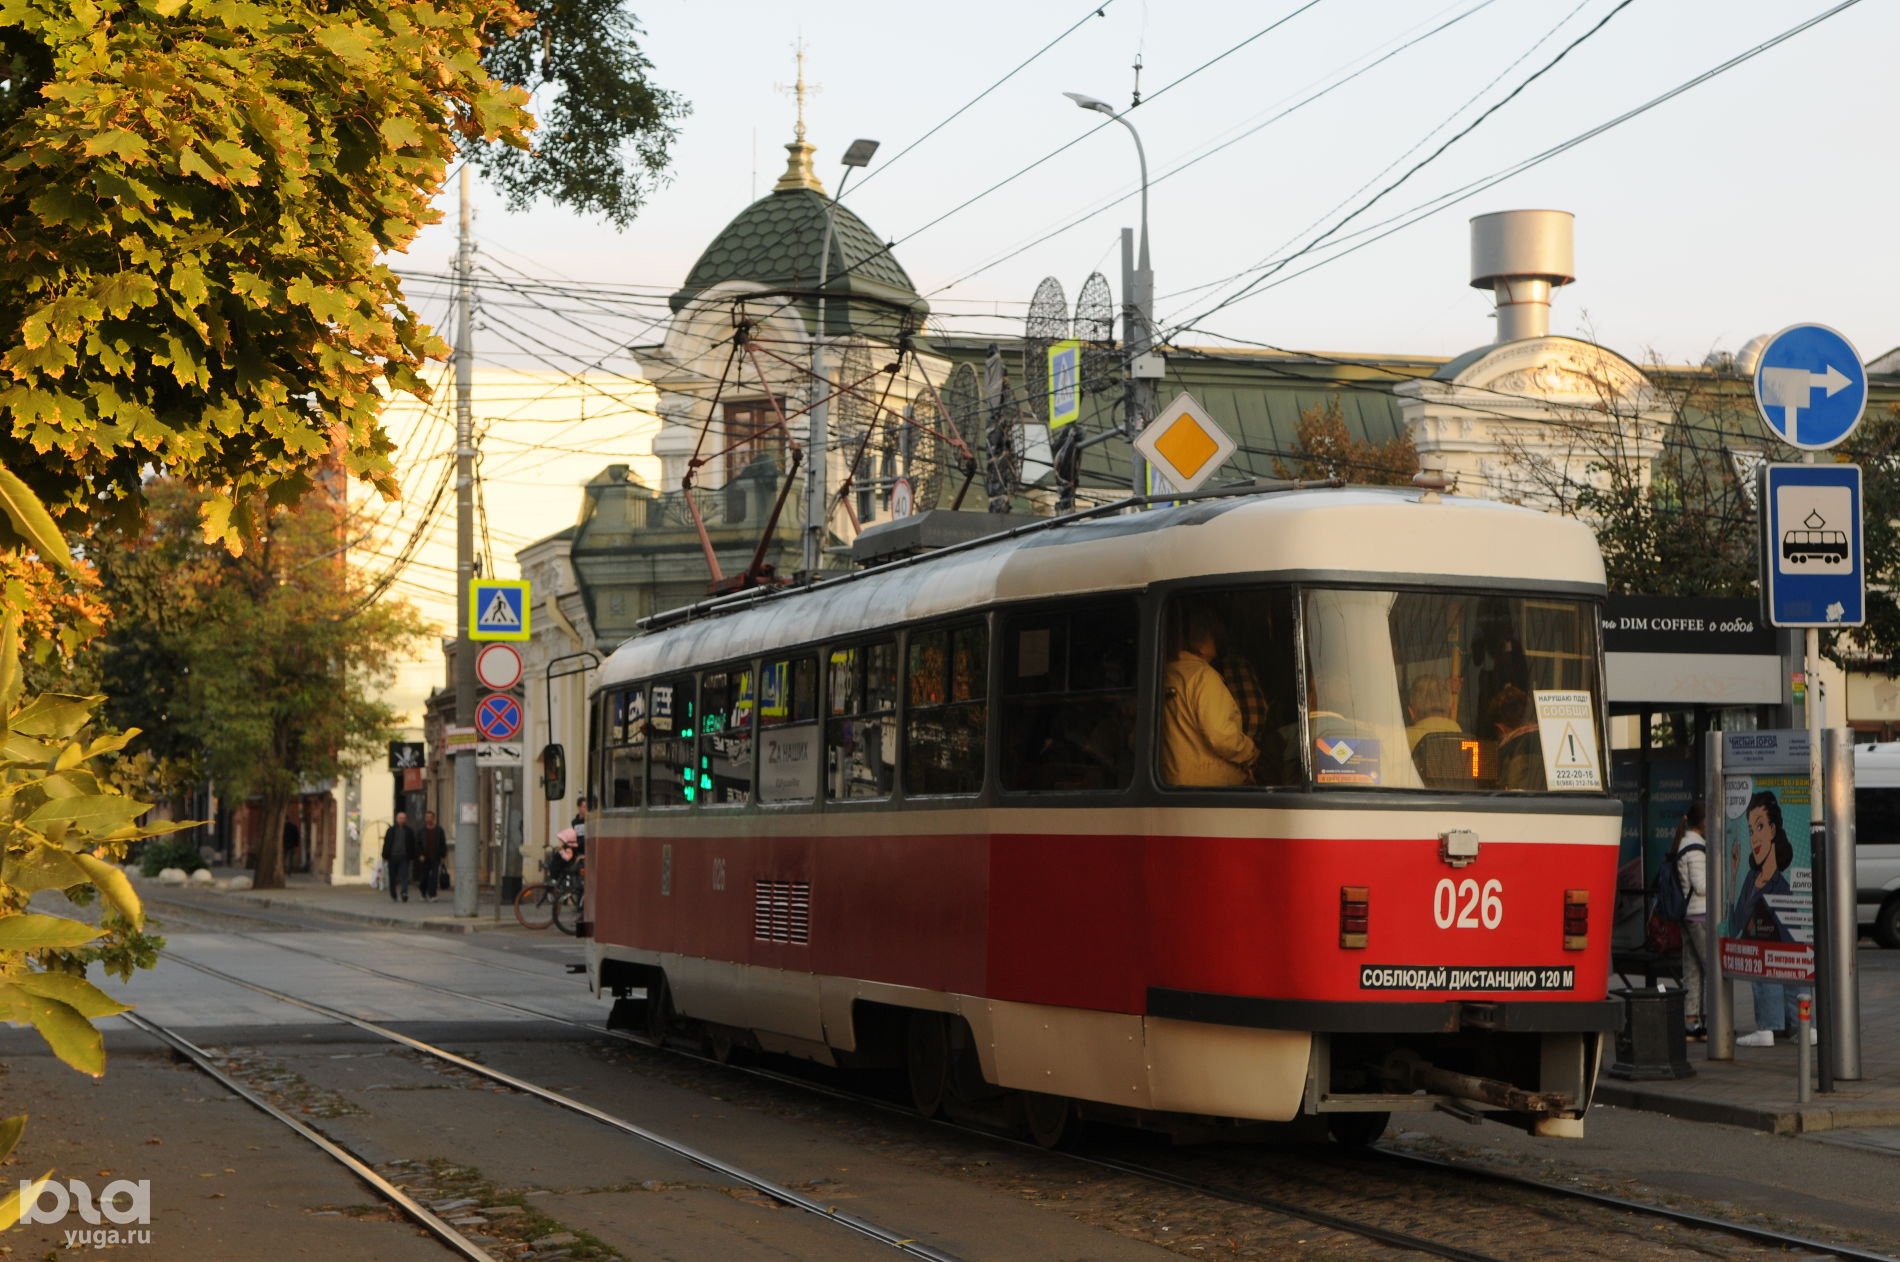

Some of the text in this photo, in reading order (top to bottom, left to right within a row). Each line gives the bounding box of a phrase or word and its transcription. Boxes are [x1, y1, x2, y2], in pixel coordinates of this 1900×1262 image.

[1620, 617, 1648, 630] DIM
[1651, 618, 1705, 631] COFFEE
[1461, 741, 1479, 777] 7
[1434, 878, 1503, 930] 026
[1362, 967, 1573, 990] СОБЛЮДАЙ ДИСТАНЦИЮ 120 М
